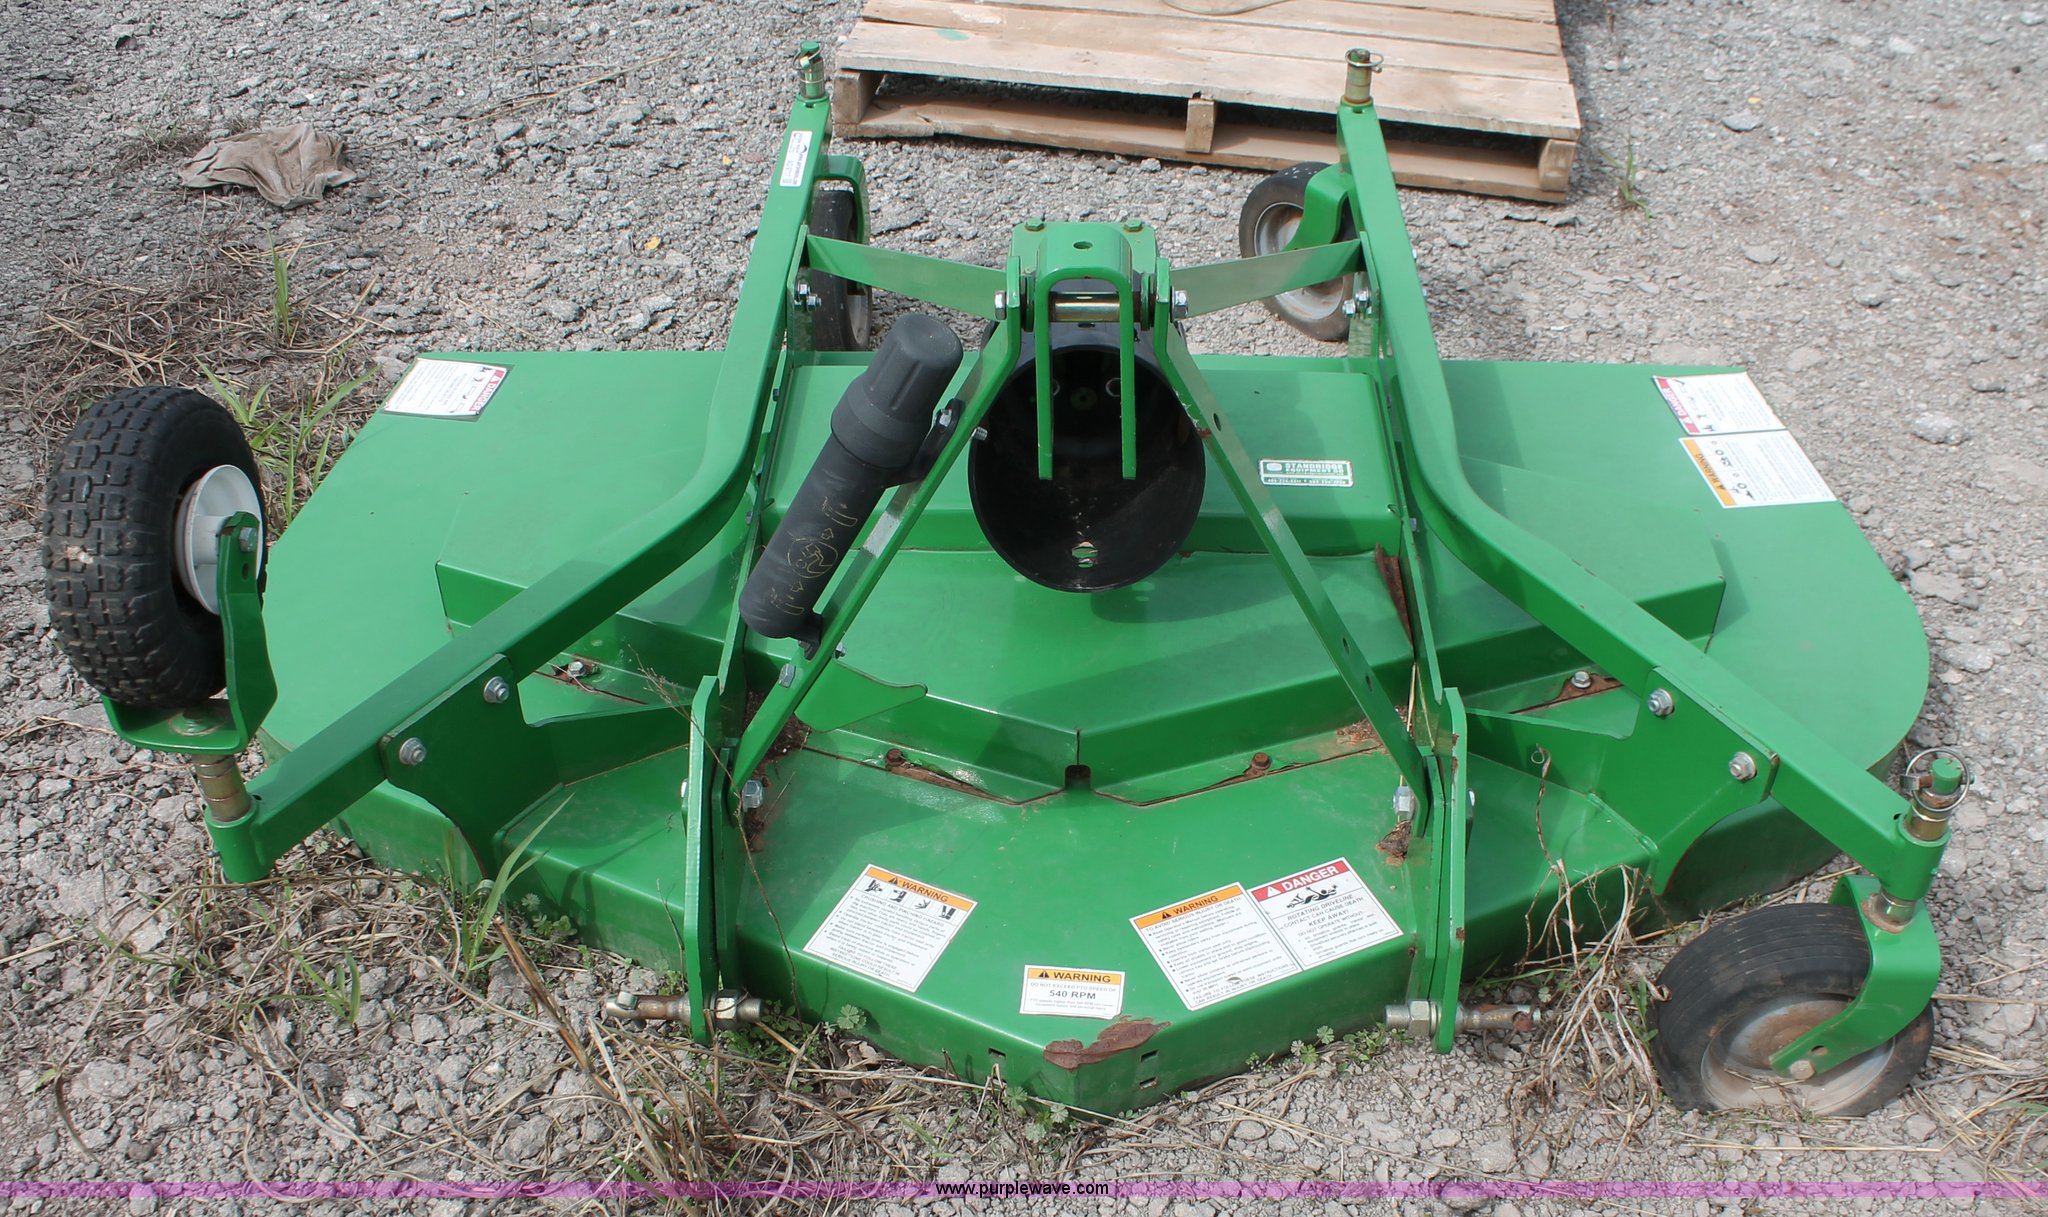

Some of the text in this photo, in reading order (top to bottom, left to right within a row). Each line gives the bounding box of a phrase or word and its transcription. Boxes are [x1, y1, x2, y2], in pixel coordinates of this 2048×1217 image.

[468, 381, 498, 411] DANGER
[1664, 387, 1689, 417] DANGER
[1695, 453, 1720, 483] WARNING
[1281, 865, 1340, 891] DANGER
[900, 881, 950, 903] WARNING
[1172, 895, 1220, 916] WARNING
[1283, 915, 1311, 928] CONTACT
[1324, 904, 1344, 914] CAUSE
[1344, 896, 1365, 907] DEATH
[1286, 894, 1354, 921] ROTATING DRIVELINE
[1307, 917, 1327, 927] KEEP
[1053, 971, 1111, 983] WARNING
[1049, 990, 1096, 999] 540 RPM
